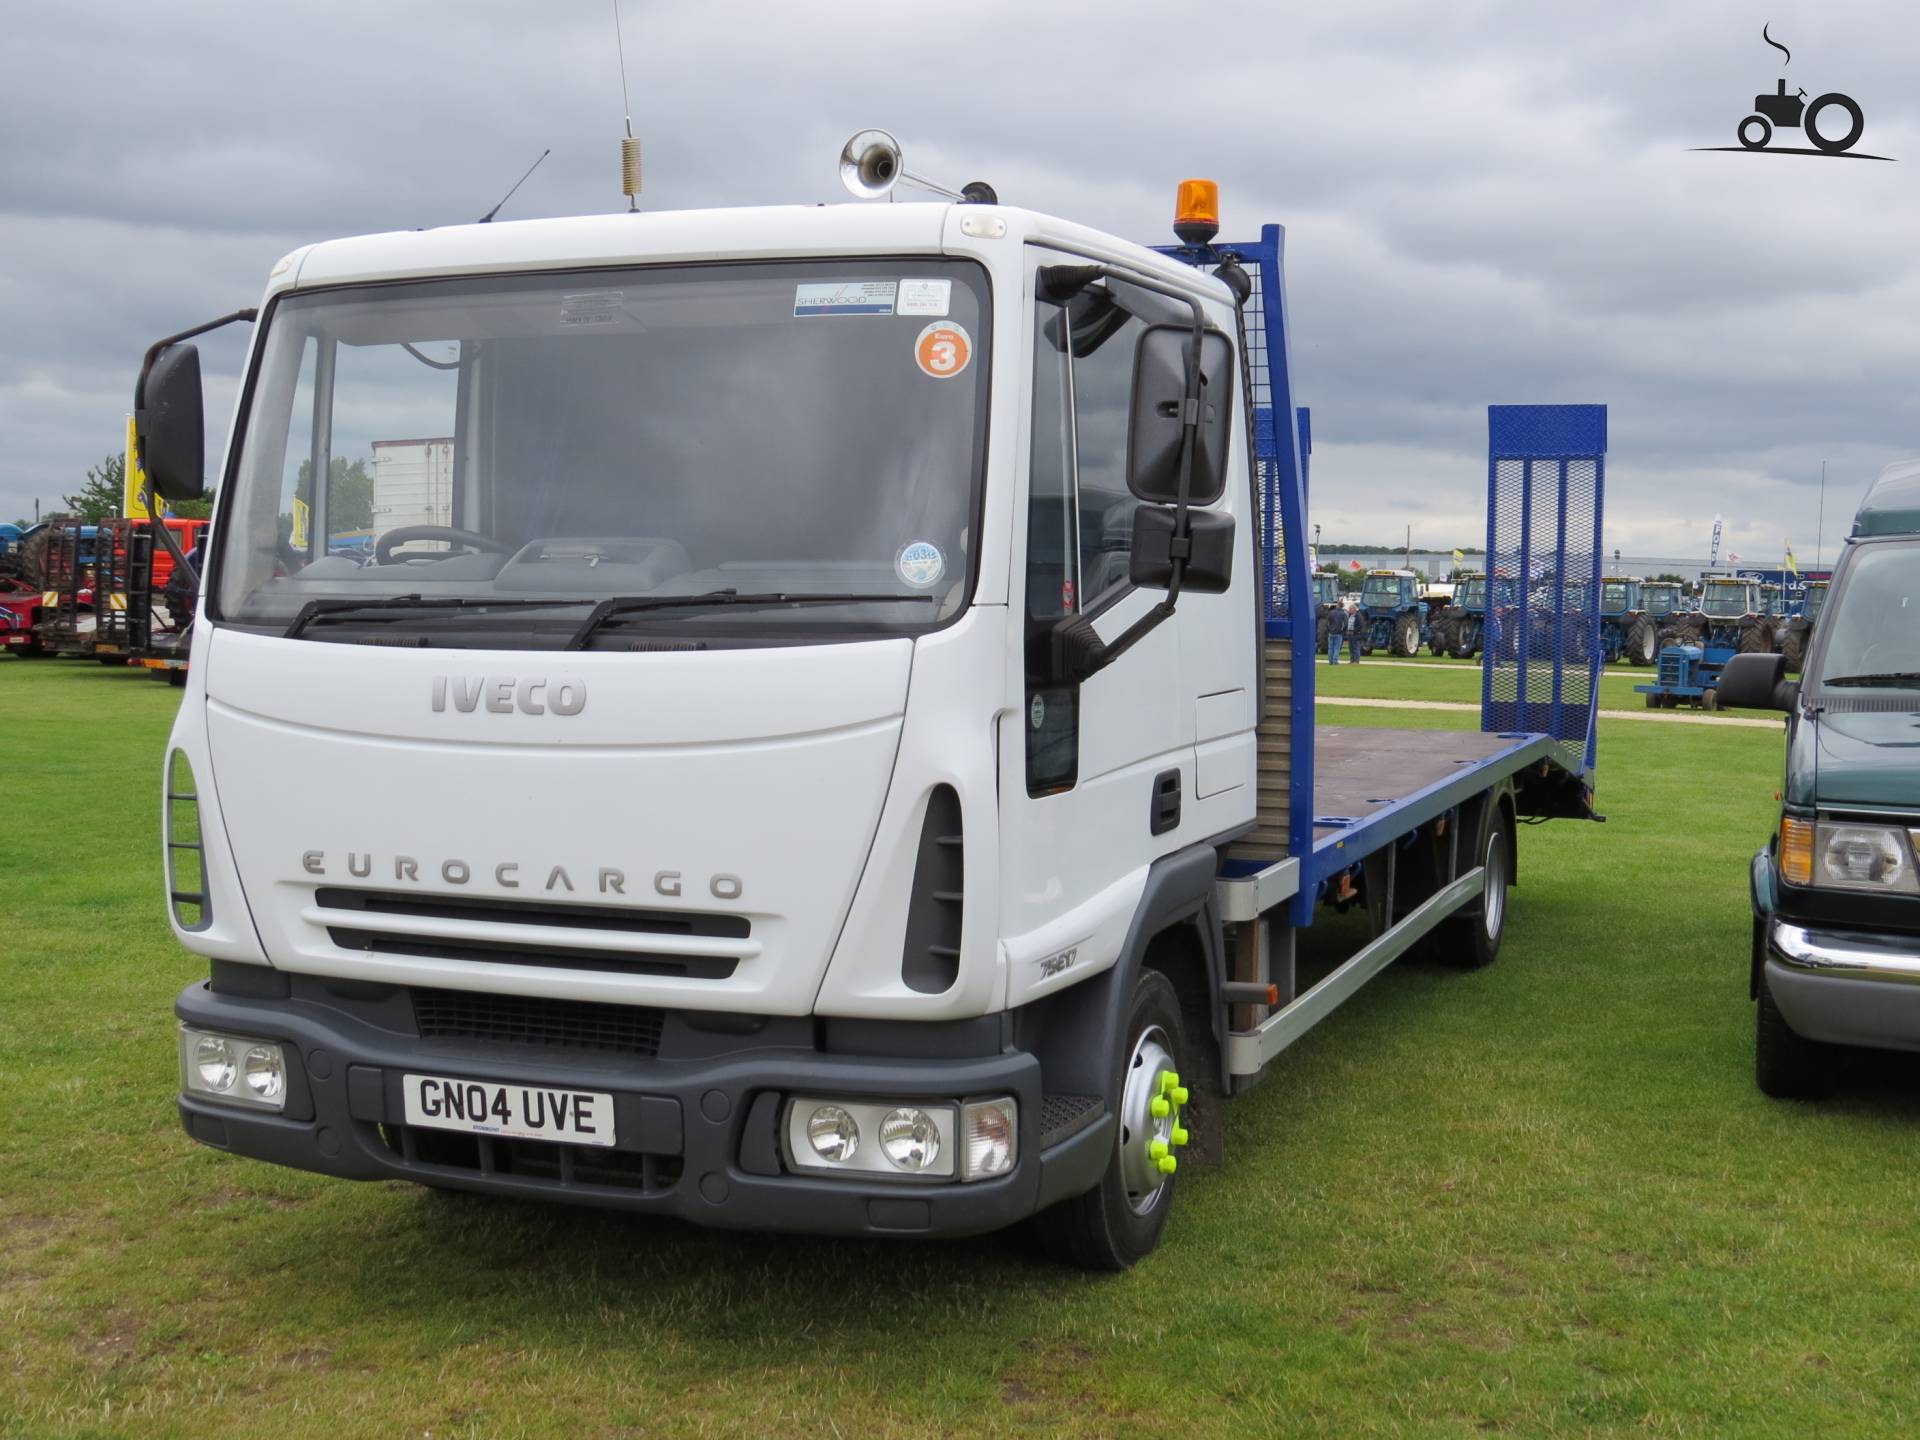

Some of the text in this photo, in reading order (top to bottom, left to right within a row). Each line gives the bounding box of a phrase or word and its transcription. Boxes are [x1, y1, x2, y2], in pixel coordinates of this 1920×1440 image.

[798, 296, 867, 305] SHERWOOD
[929, 341, 956, 371] 3
[431, 675, 587, 716] IVECO
[302, 849, 743, 900] EUROCARGO
[420, 1079, 596, 1134] GN04 UVE
